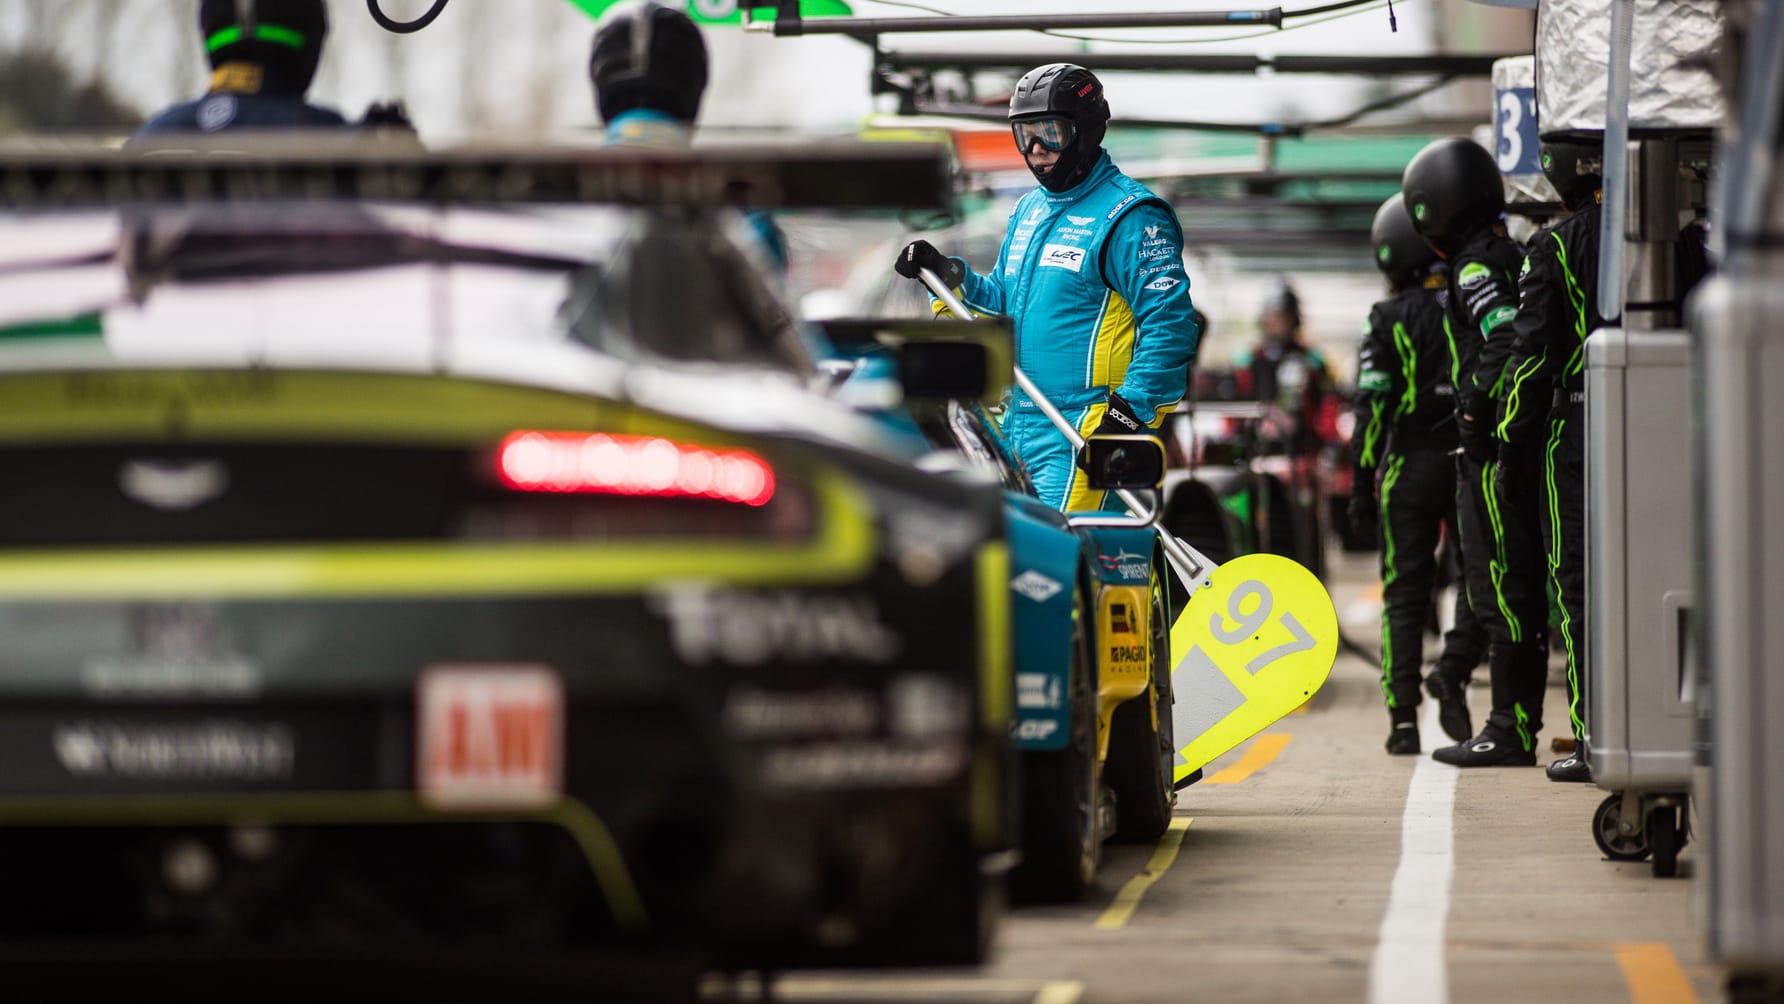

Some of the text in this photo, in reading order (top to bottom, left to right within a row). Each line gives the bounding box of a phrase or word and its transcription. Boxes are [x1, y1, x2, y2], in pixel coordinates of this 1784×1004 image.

[1498, 91, 1541, 172] 3
[1050, 250, 1082, 262] WEC
[1138, 246, 1175, 259] HACKETT
[1149, 263, 1180, 274] DUNLOP
[1117, 563, 1149, 580] SPIRENT
[1209, 579, 1317, 676] 97
